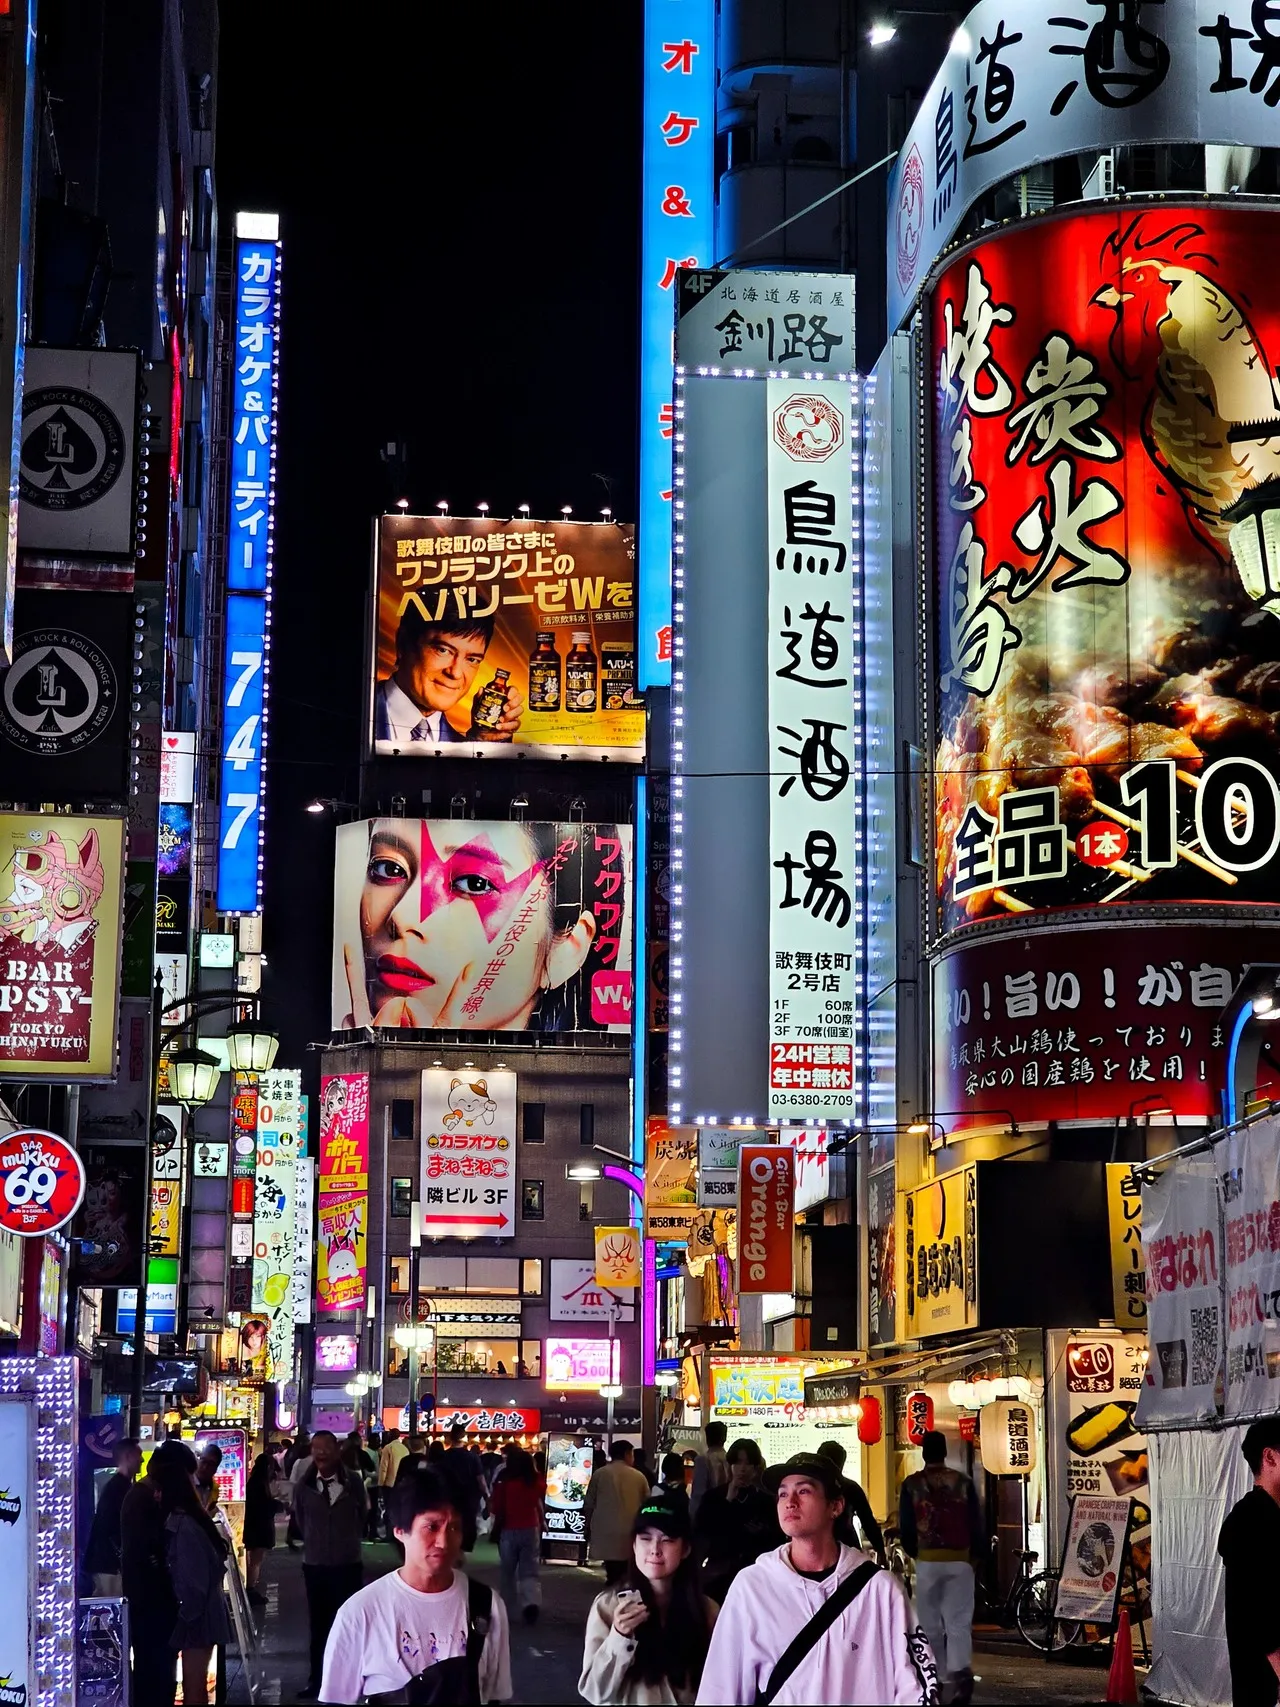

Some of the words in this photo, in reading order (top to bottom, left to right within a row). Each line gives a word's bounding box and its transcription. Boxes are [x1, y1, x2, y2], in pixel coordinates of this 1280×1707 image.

[684, 275, 713, 294] 4F
[720, 285, 845, 308] 北海道居酒屋
[714, 309, 843, 364] 釧路
[233, 252, 272, 569] カラオケ&パーティー
[1006, 334, 1131, 599] 炭火
[396, 531, 556, 558] 歌舞伎町の皆さまに
[396, 553, 576, 587] ワンランク上の
[396, 576, 634, 622] ヘパリーゼWを
[33, 633, 59, 643] ROCK
[70, 638, 89, 654] ROLL
[88, 651, 112, 685] LOUNGE
[773, 480, 852, 929] 鳥道酒場
[221, 651, 263, 850] 747
[953, 785, 1068, 901] 全品
[1079, 831, 1122, 858] 1本
[593, 836, 622, 965] ワクワク
[459, 836, 578, 1021] わたしが主役の世界線。
[7, 960, 74, 982] BAR
[775, 951, 853, 971] 歌舞伎町
[787, 973, 841, 992] 2号店
[774, 999, 790, 1010] 1F
[825, 1000, 853, 1012] 60席
[10, 1023, 65, 1034] TOKYO
[774, 1013, 791, 1023] 2F
[817, 1013, 853, 1025] 100席
[774, 1026, 791, 1036] 3F
[794, 1026, 853, 1039] 70席(個室)
[773, 1045, 851, 1066] 24H営業
[773, 1067, 851, 1088] 年中無休
[964, 1055, 1207, 1097] 安心の国産鶏を使用！
[771, 1094, 853, 1106] 03-6380-2709
[20, 1140, 43, 1152] BAR
[325, 1133, 359, 1157] ポケ
[438, 1133, 499, 1151] カラオケ
[330, 1152, 363, 1174] パラ
[426, 1153, 509, 1180] まねきねこ
[4, 1166, 57, 1205] 69
[426, 1187, 478, 1205] 隣ビル
[483, 1188, 509, 1205] 3F
[22, 1214, 39, 1224] B2F
[321, 1209, 362, 1236] 高収入
[743, 1156, 774, 1281] Orange
[775, 1199, 790, 1230] Bar
[327, 1227, 365, 1253] バイト
[122, 1291, 173, 1300] FayMart
[564, 1416, 642, 1426] 山下本うど
[911, 1400, 928, 1436] おでん
[1007, 1407, 1029, 1467] 鳥道酒場
[1066, 1478, 1101, 1492] 590円
[1075, 1511, 1088, 1520] AND
[1088, 1512, 1111, 1521] NATURAL
[1112, 1513, 1127, 1522] WINE
[1077, 1499, 1101, 1509] JAPANESE
[1100, 1500, 1115, 1510] CRAFT
[1115, 1501, 1128, 1511] BEER
